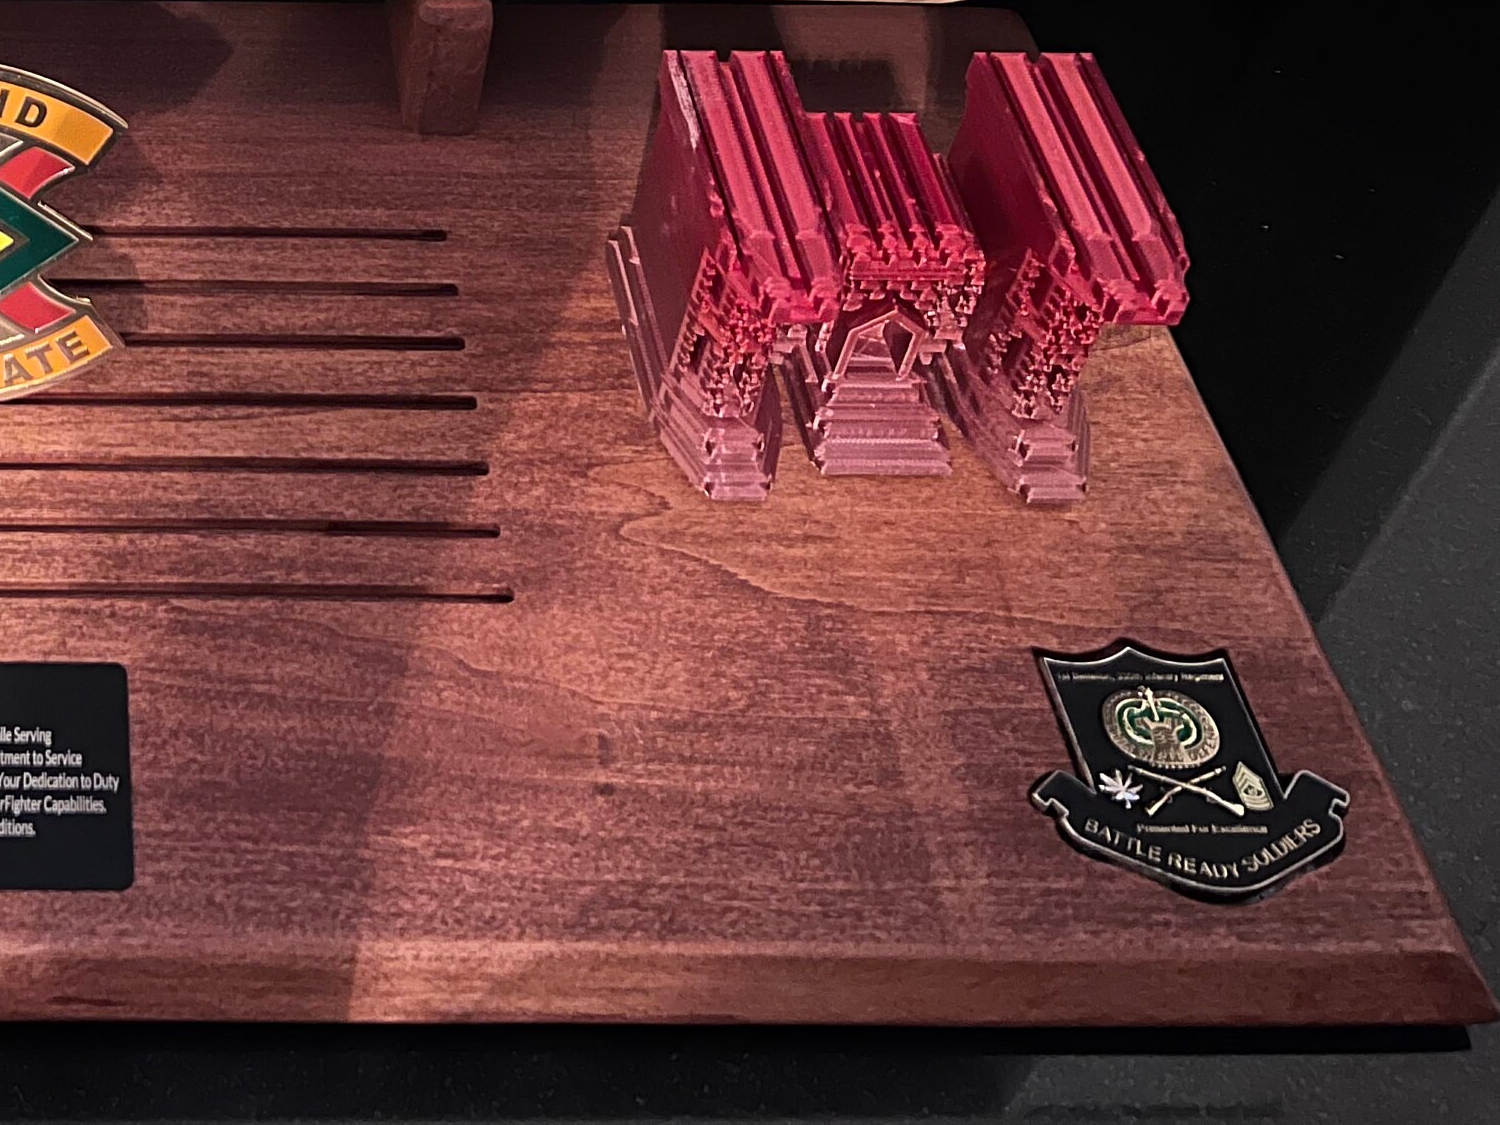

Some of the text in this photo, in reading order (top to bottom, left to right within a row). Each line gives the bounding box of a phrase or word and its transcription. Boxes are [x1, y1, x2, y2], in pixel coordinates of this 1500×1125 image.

[13, 727, 52, 746] Serving
[32, 750, 44, 766] to
[45, 749, 83, 766] Service
[23, 773, 79, 789] Dedication
[80, 774, 92, 789] to
[93, 773, 119, 793] Duty
[43, 795, 107, 814] Capabilities.
[1084, 817, 1322, 879] BATTLE READY SOLDIERS
